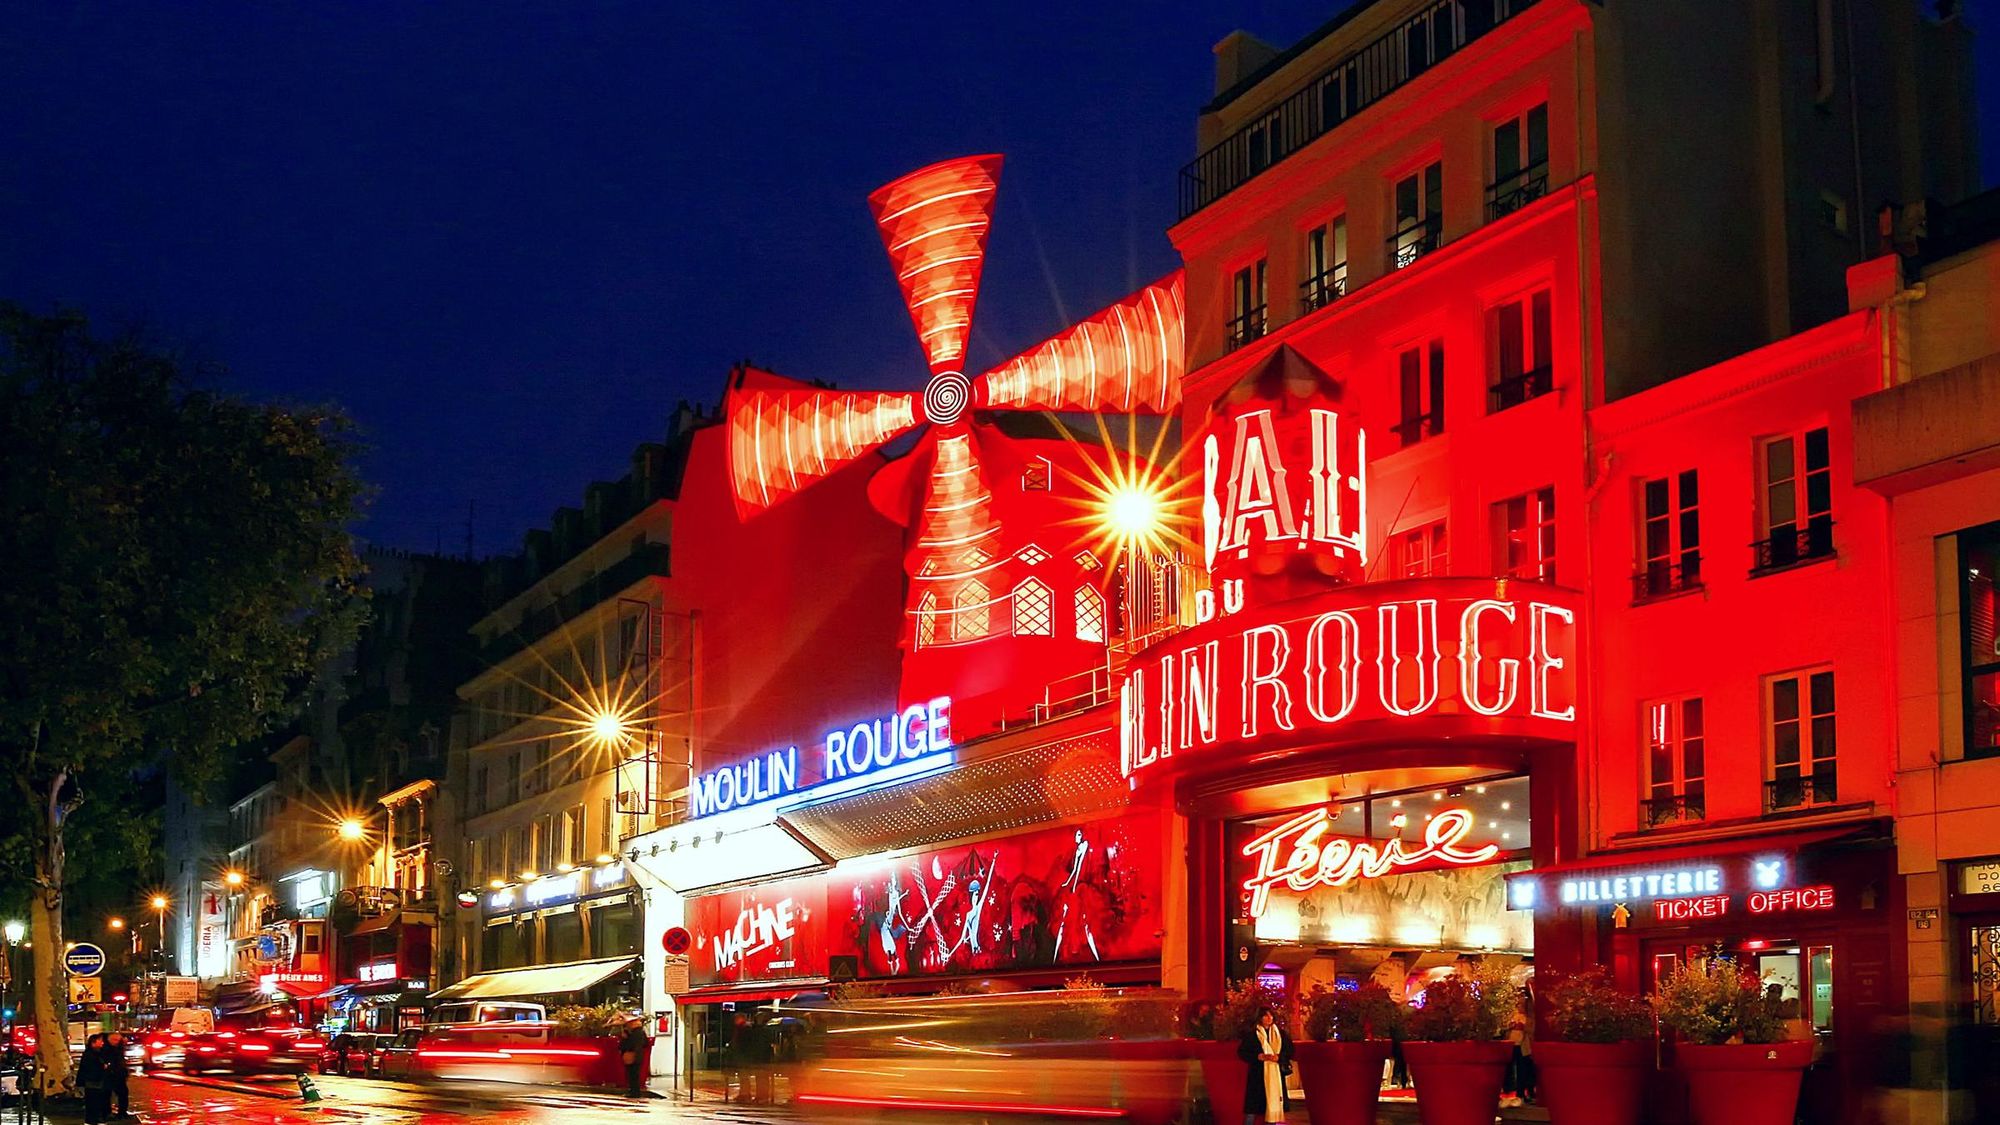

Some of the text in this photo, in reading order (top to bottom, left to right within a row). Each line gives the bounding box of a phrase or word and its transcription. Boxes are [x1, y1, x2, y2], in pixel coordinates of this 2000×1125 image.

[1203, 409, 1368, 574] AL
[1195, 579, 1244, 623] DU
[1241, 599, 1576, 737] ROUGE
[692, 695, 952, 818] MOULIN ROUGE
[1563, 869, 1720, 902] BILLETTERIE
[1655, 888, 1835, 921] TICKET OFFICE
[713, 897, 796, 973] MACHINE
